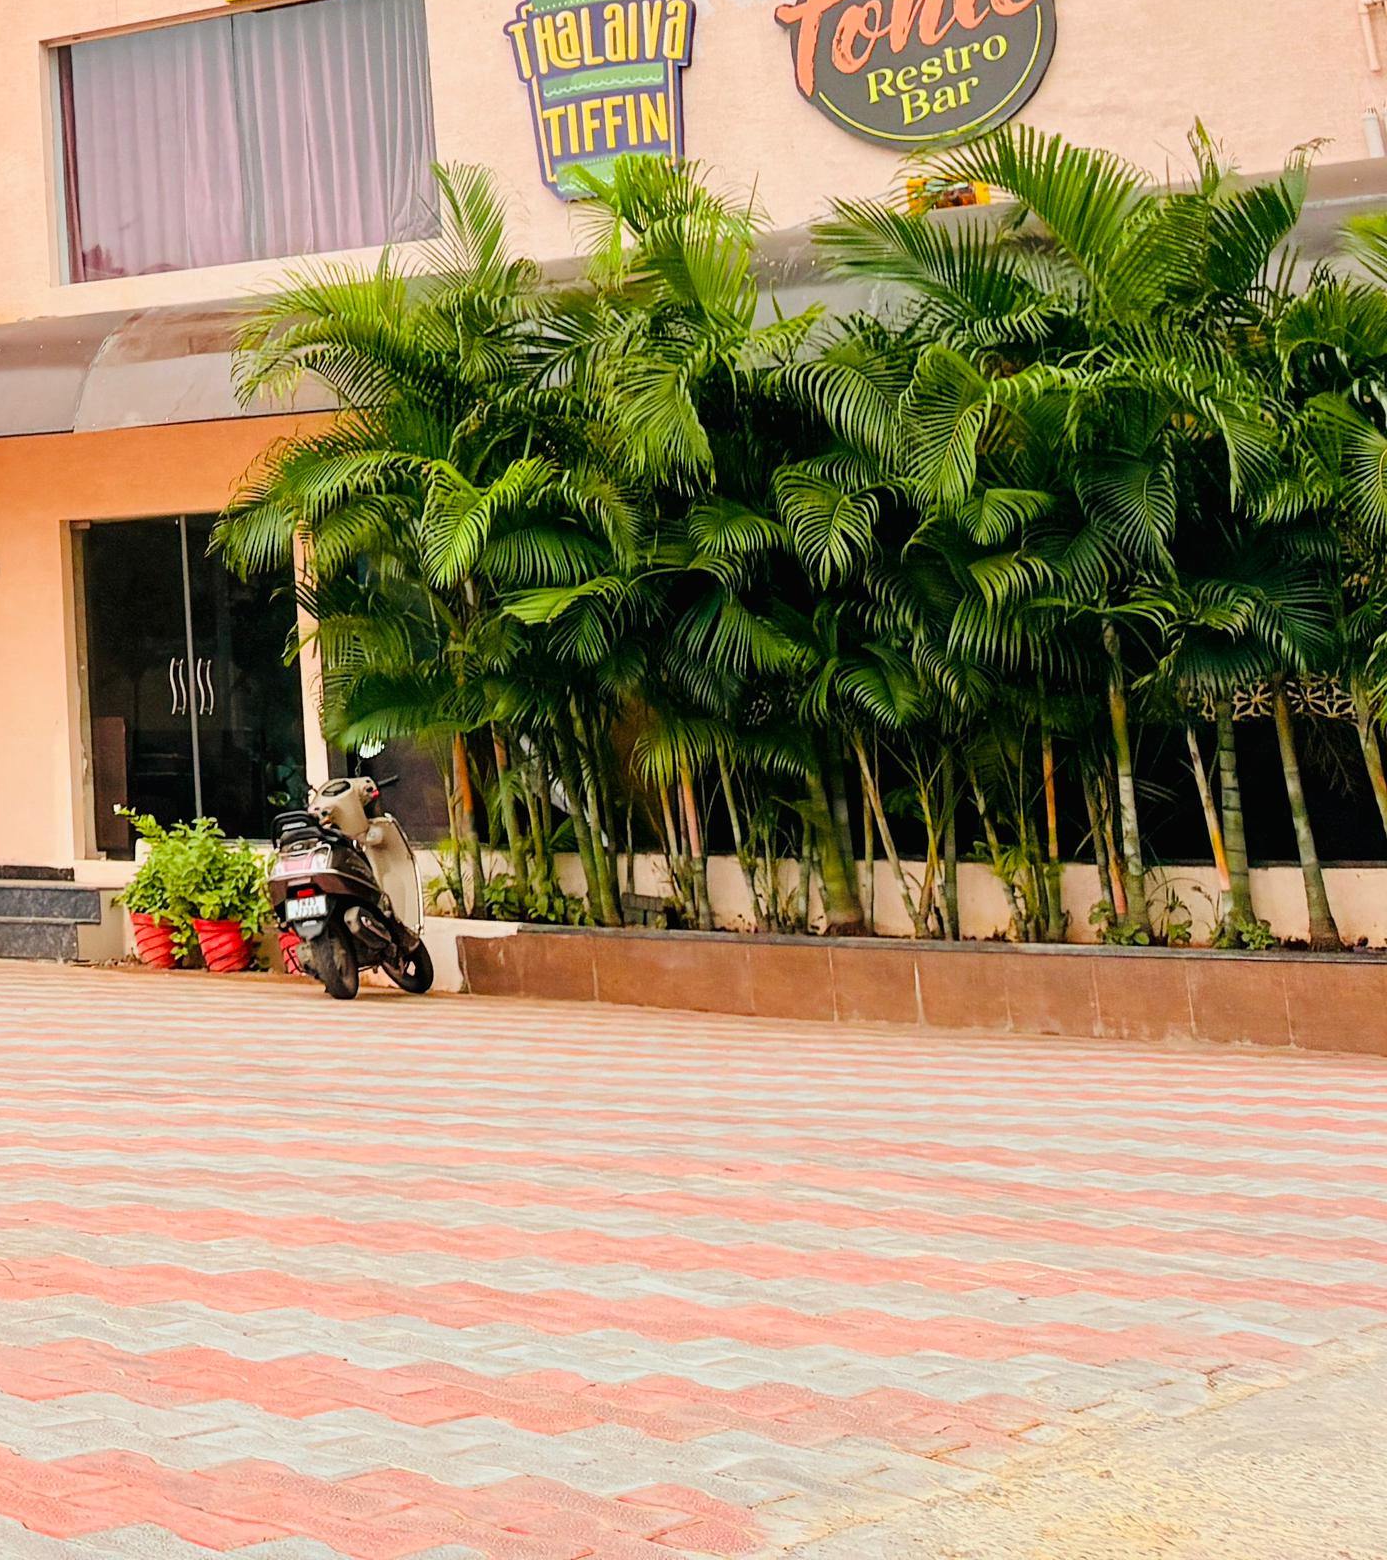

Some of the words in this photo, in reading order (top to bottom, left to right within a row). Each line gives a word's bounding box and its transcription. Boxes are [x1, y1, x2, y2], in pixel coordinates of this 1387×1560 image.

[867, 33, 1008, 105] Restro
[900, 76, 980, 126] Bar
[542, 91, 669, 158] TIFFIN
